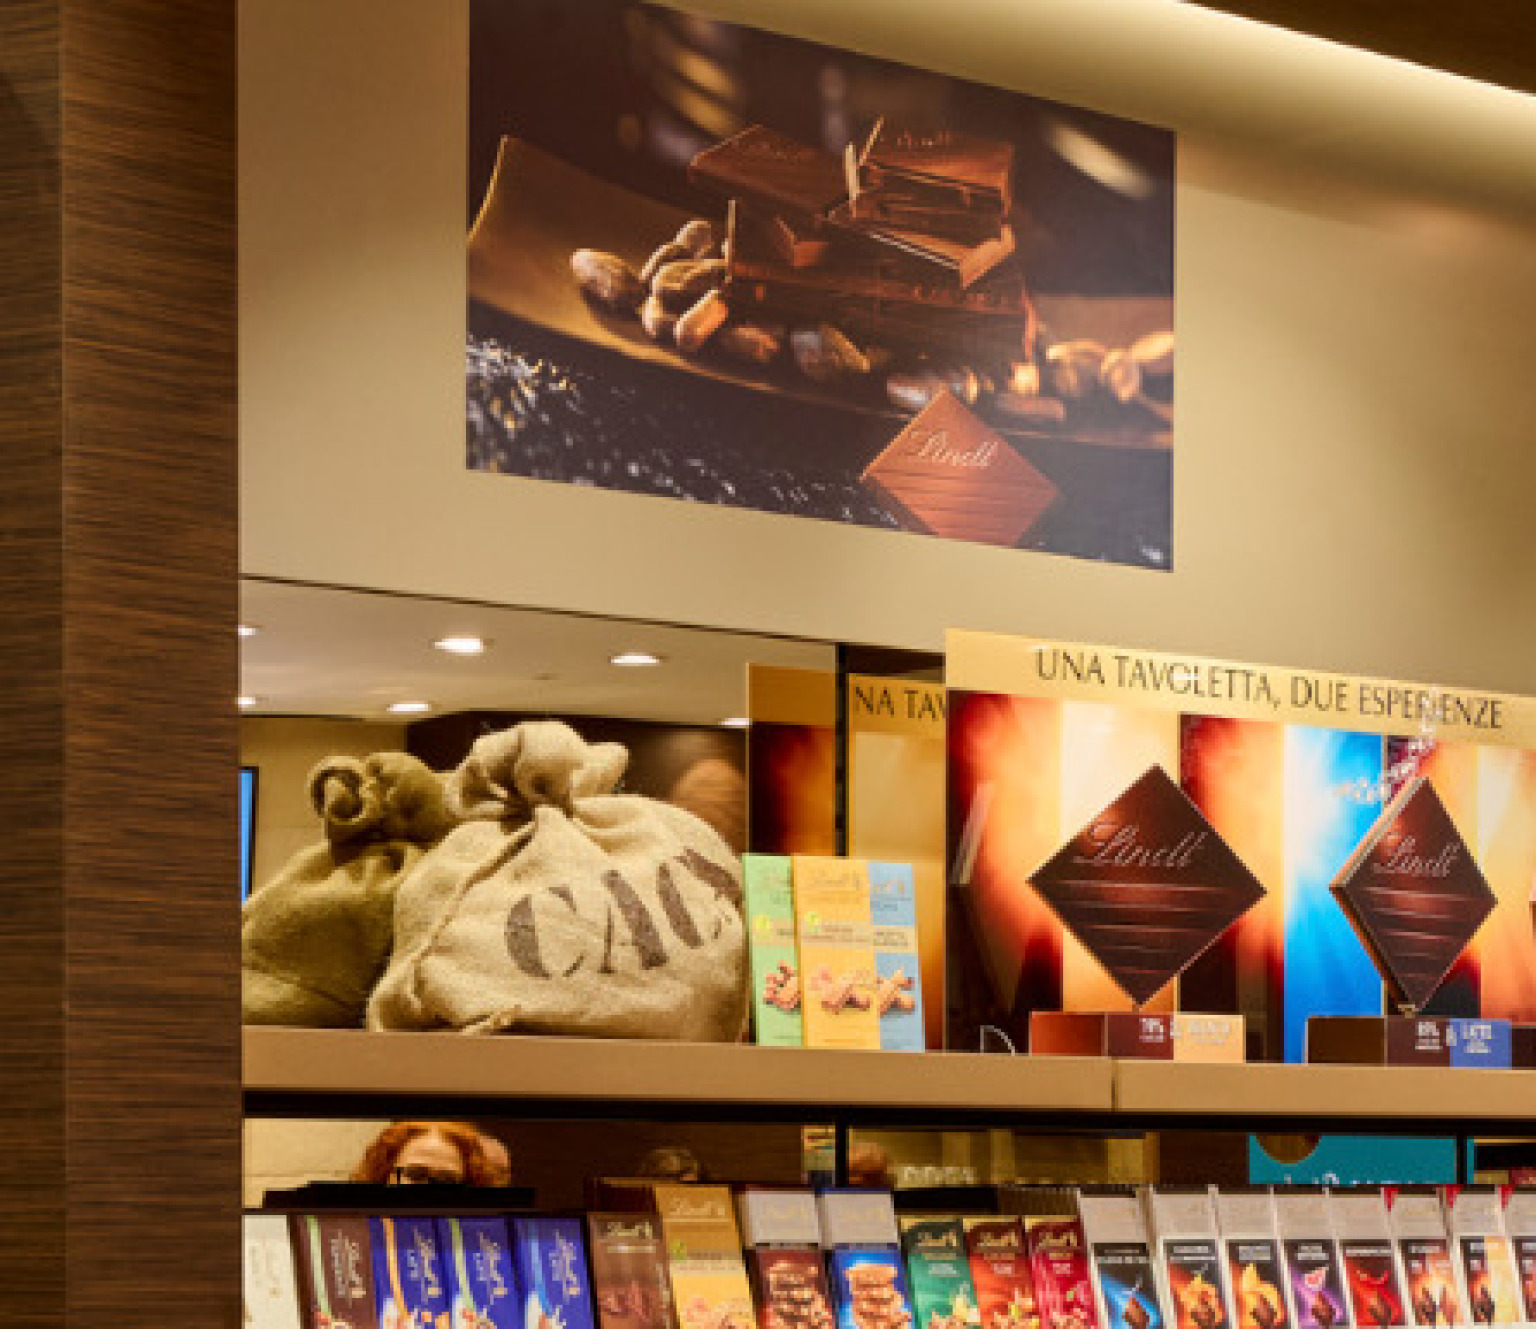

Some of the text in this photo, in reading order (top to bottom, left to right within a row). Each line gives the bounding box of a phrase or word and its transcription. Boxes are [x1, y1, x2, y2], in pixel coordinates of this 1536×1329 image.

[903, 429, 999, 468] Lindt
[854, 685, 947, 720] NA TAV
[1036, 648, 1504, 731] UNA TAVOLETTA, DUE ESPERIENZE
[1073, 820, 1206, 869] Lindt
[1371, 831, 1463, 879] Lindt
